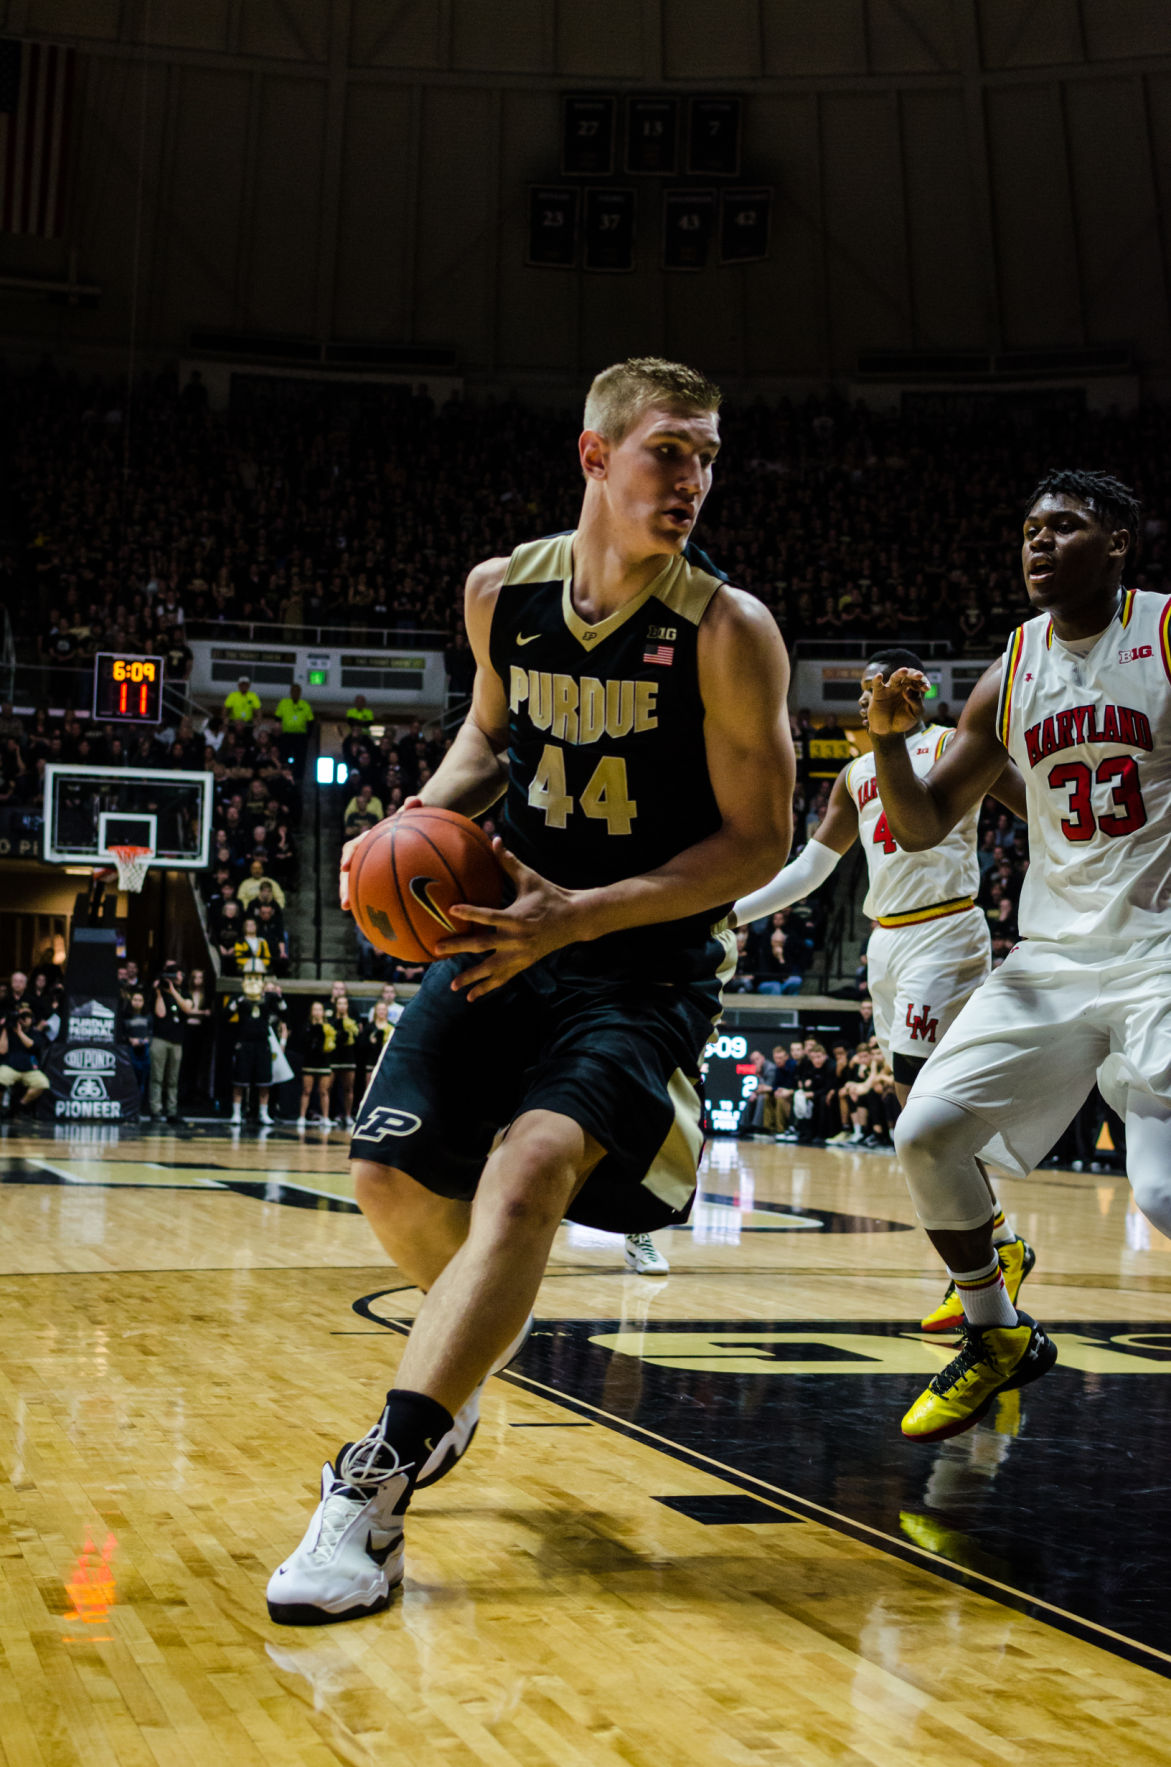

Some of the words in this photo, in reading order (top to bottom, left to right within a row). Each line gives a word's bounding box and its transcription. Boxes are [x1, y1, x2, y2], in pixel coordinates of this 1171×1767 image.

[707, 119, 722, 137] 7
[112, 660, 156, 683] 6:09
[119, 682, 148, 715] 11
[508, 664, 659, 745] PURDUE
[1023, 703, 1154, 769] MARYLAND
[527, 744, 639, 836] 44
[1047, 755, 1148, 842] 33
[55, 1100, 122, 1119] PIONEER
[352, 1106, 423, 1143] P
